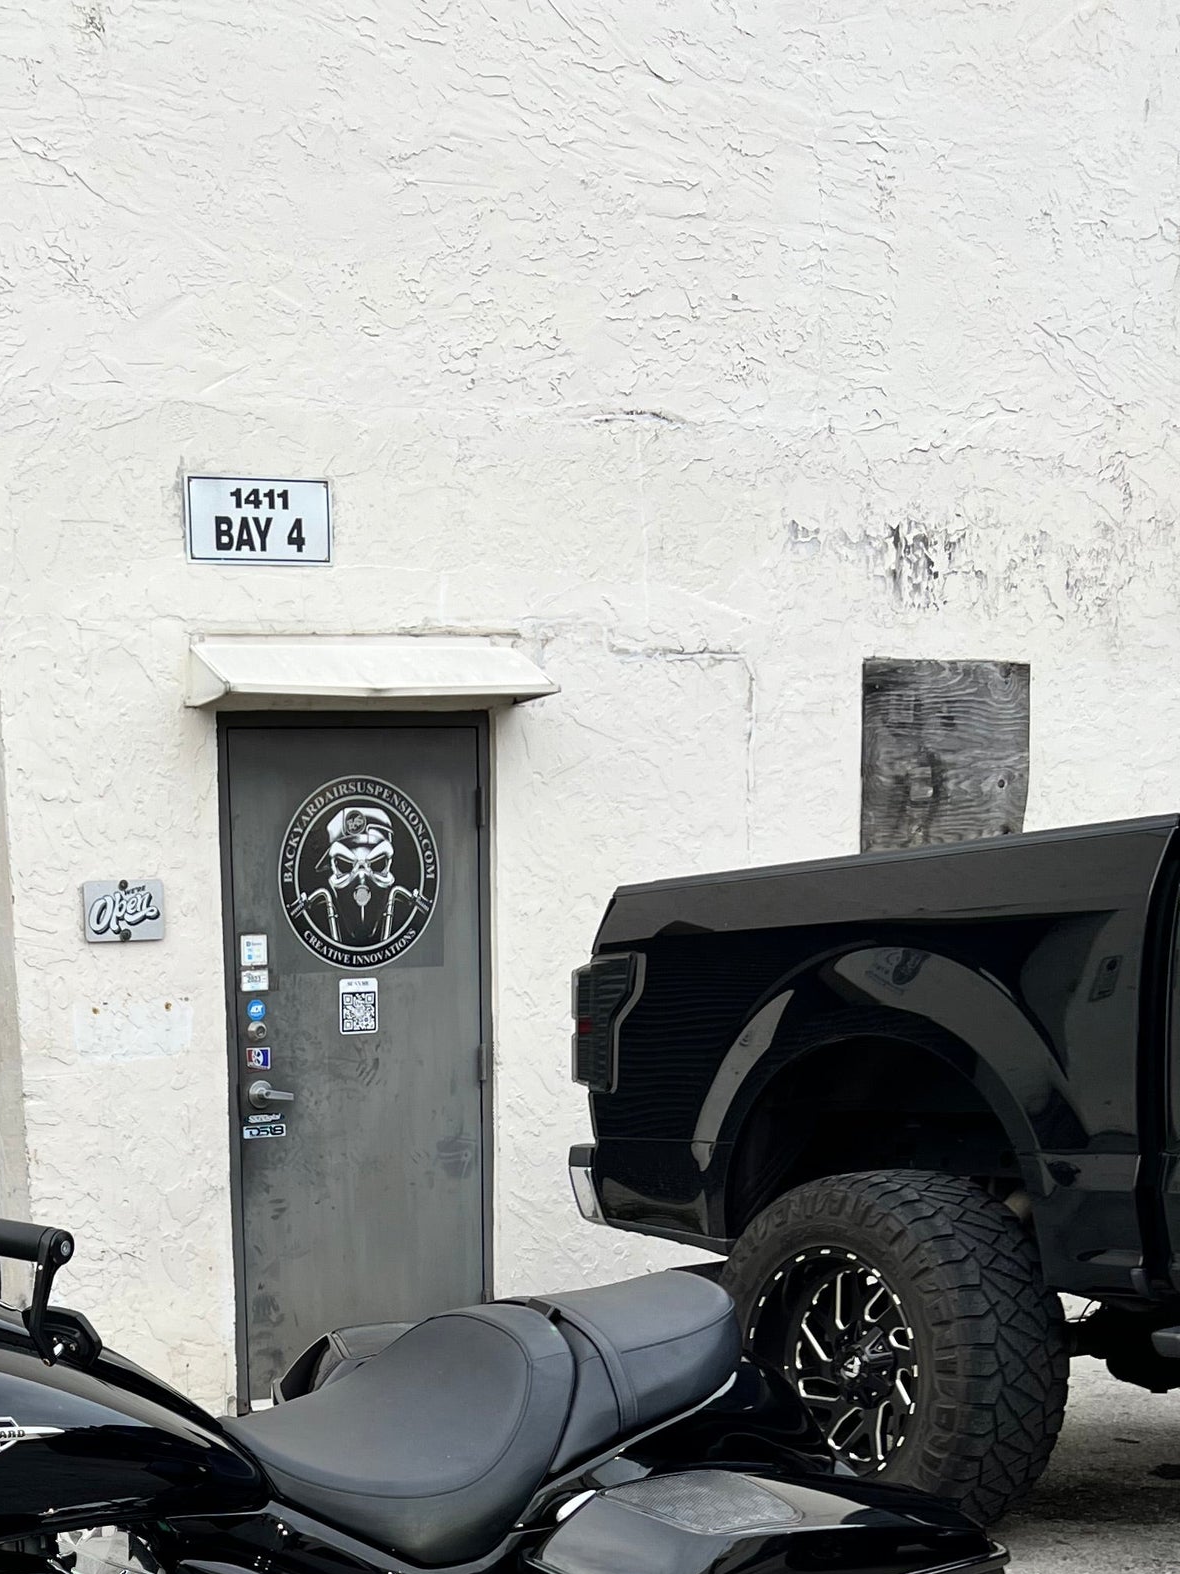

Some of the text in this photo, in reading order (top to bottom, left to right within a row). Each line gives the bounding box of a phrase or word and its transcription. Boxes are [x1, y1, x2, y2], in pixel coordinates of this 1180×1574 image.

[230, 487, 289, 510] 1411
[214, 515, 306, 553] BAY 4
[283, 780, 436, 884] BACKYARDAIRSUSPENSION.COM
[89, 891, 153, 935] Open
[303, 928, 417, 965] CREATIVE INNOVATIONS
